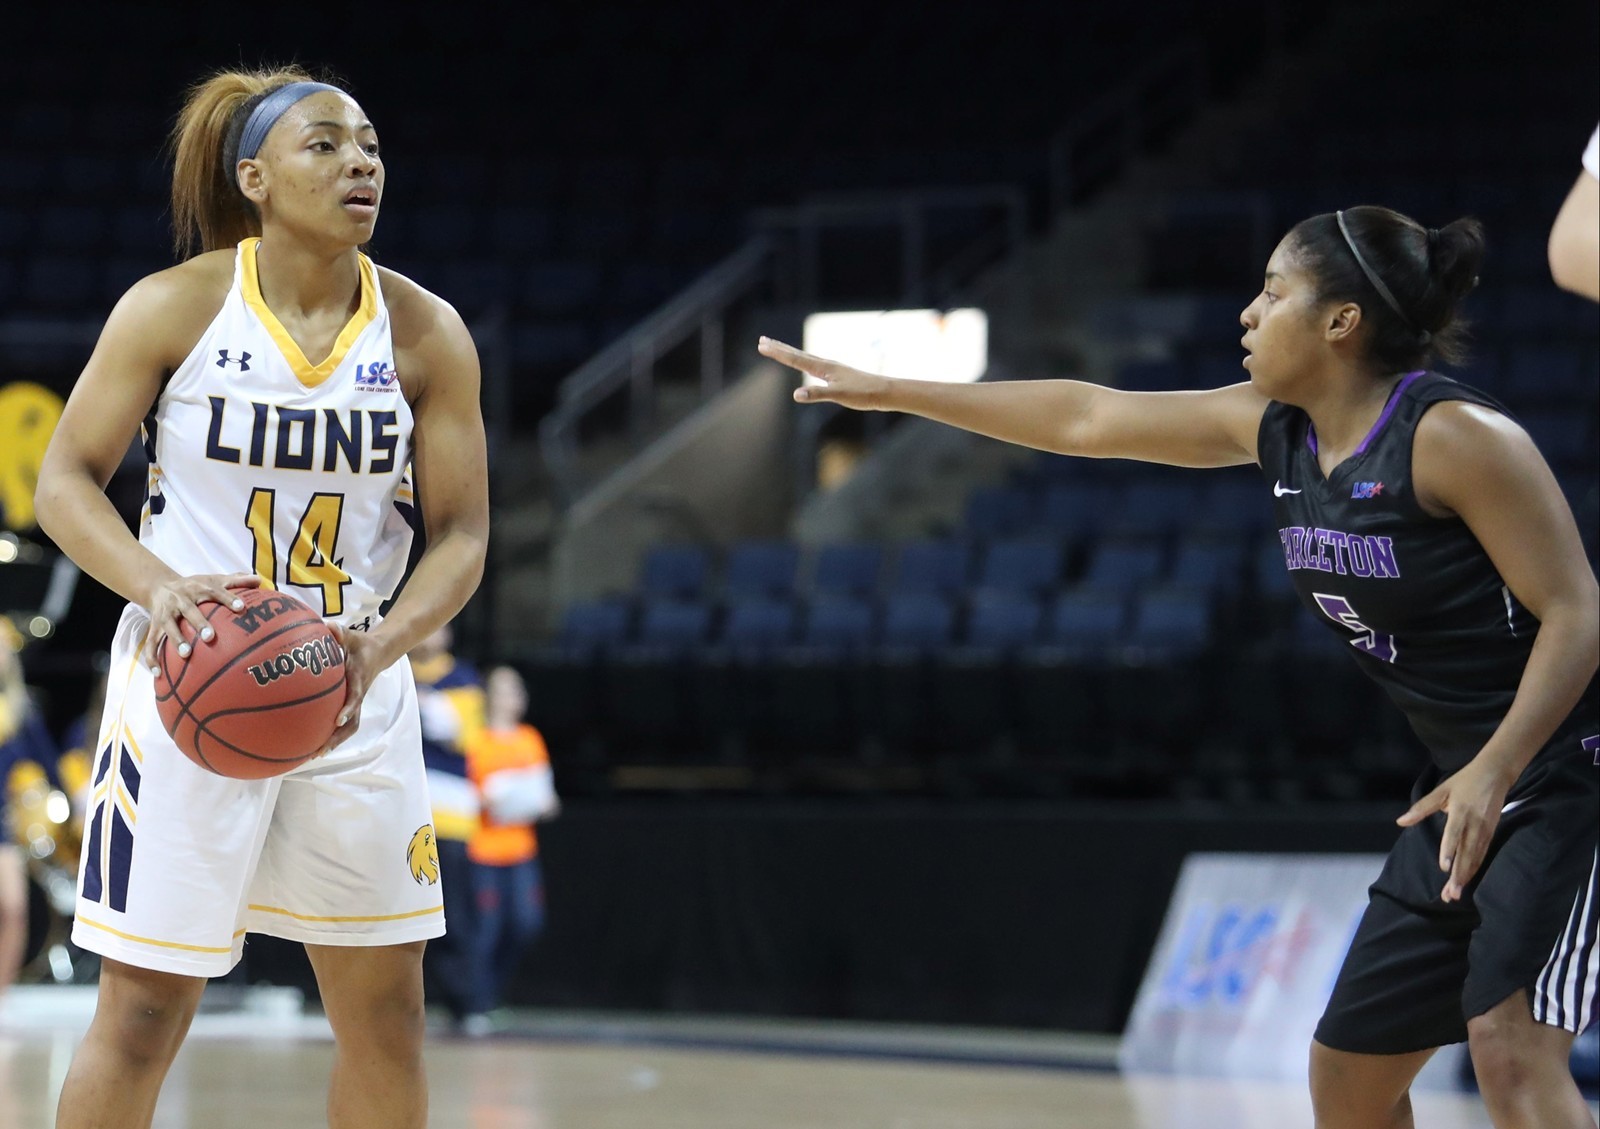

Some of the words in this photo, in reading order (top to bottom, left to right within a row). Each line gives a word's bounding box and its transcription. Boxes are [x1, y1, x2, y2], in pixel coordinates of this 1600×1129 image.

[355, 361, 388, 386] LSC
[206, 395, 399, 475] LIONS
[245, 487, 352, 617] 14
[232, 595, 308, 634] NCAA
[1312, 592, 1397, 664] 5
[247, 634, 345, 686] Wilson
